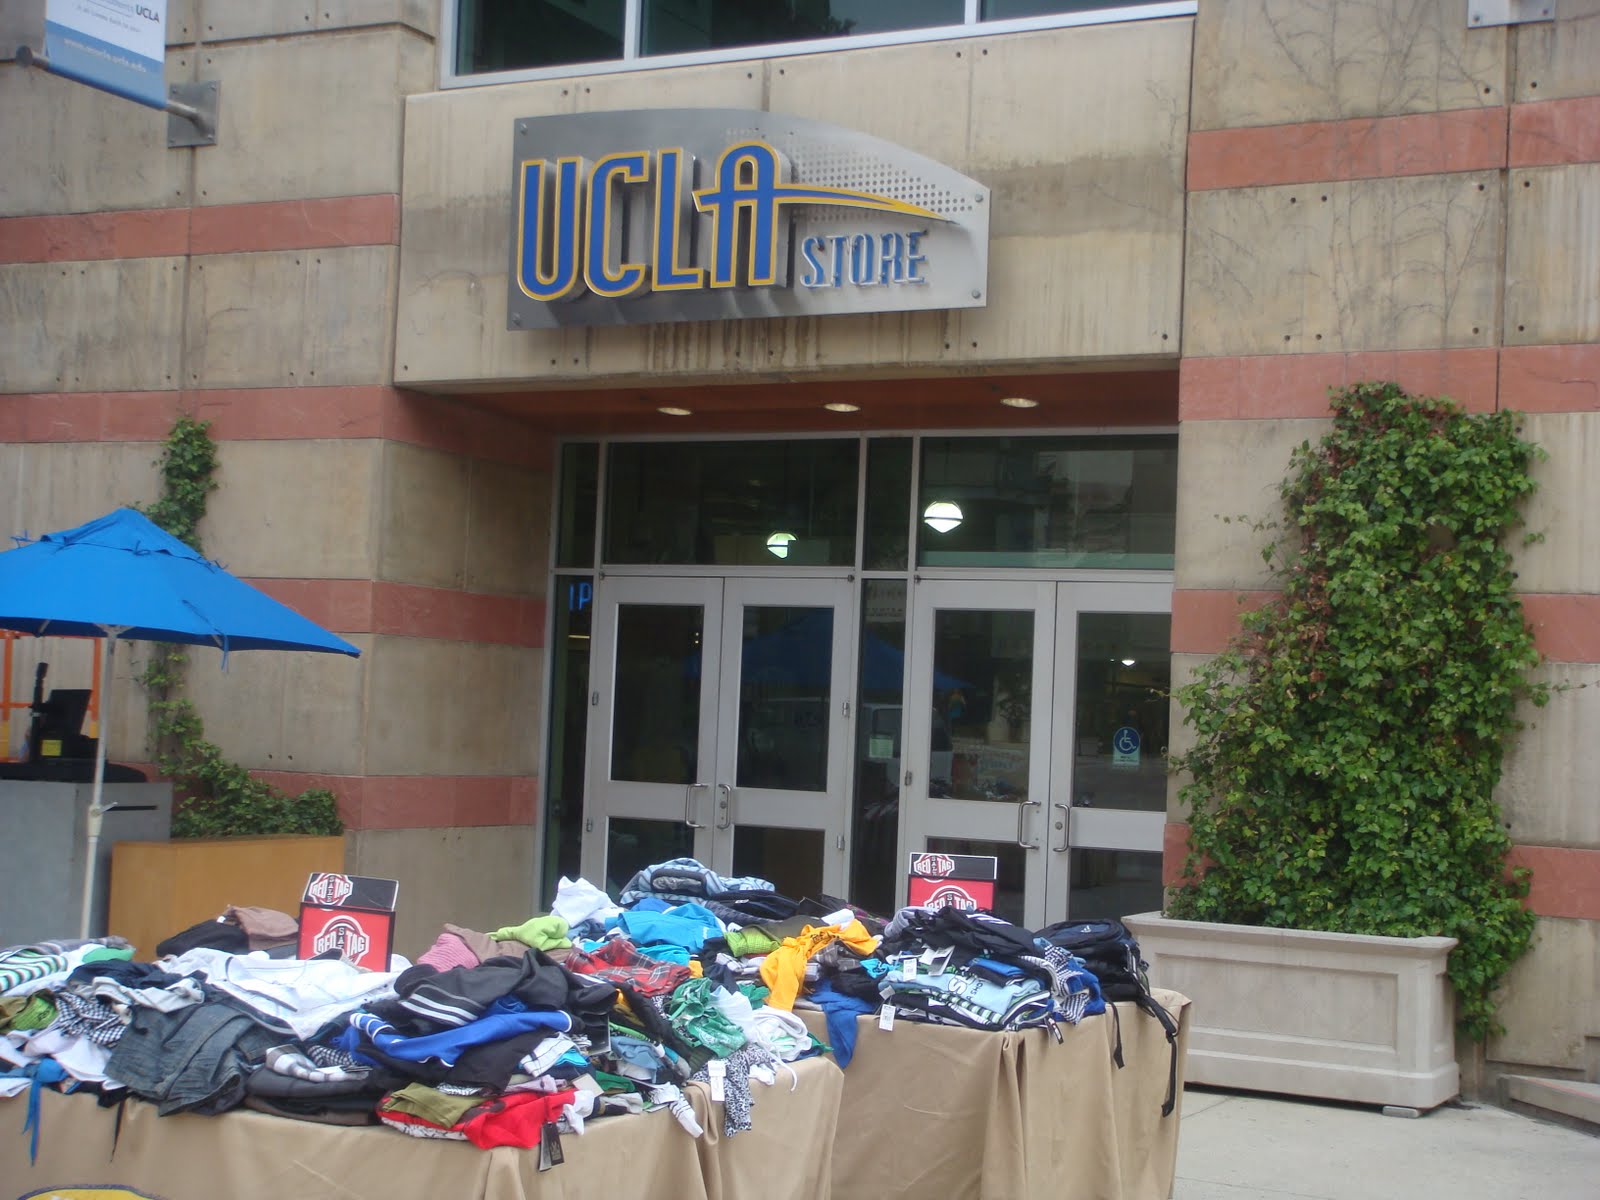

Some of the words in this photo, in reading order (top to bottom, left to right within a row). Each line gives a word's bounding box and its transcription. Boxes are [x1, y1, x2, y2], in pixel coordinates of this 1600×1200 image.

[135, 4, 160, 24] UCLA
[517, 140, 787, 301] UCLA
[801, 229, 929, 288] STORE
[917, 859, 931, 874] RED
[937, 858, 951, 874] TAG
[311, 880, 328, 899] RED
[335, 878, 349, 899] TAG
[327, 876, 336, 902] SALE
[317, 931, 337, 952] RED
[345, 931, 365, 957] TAG
